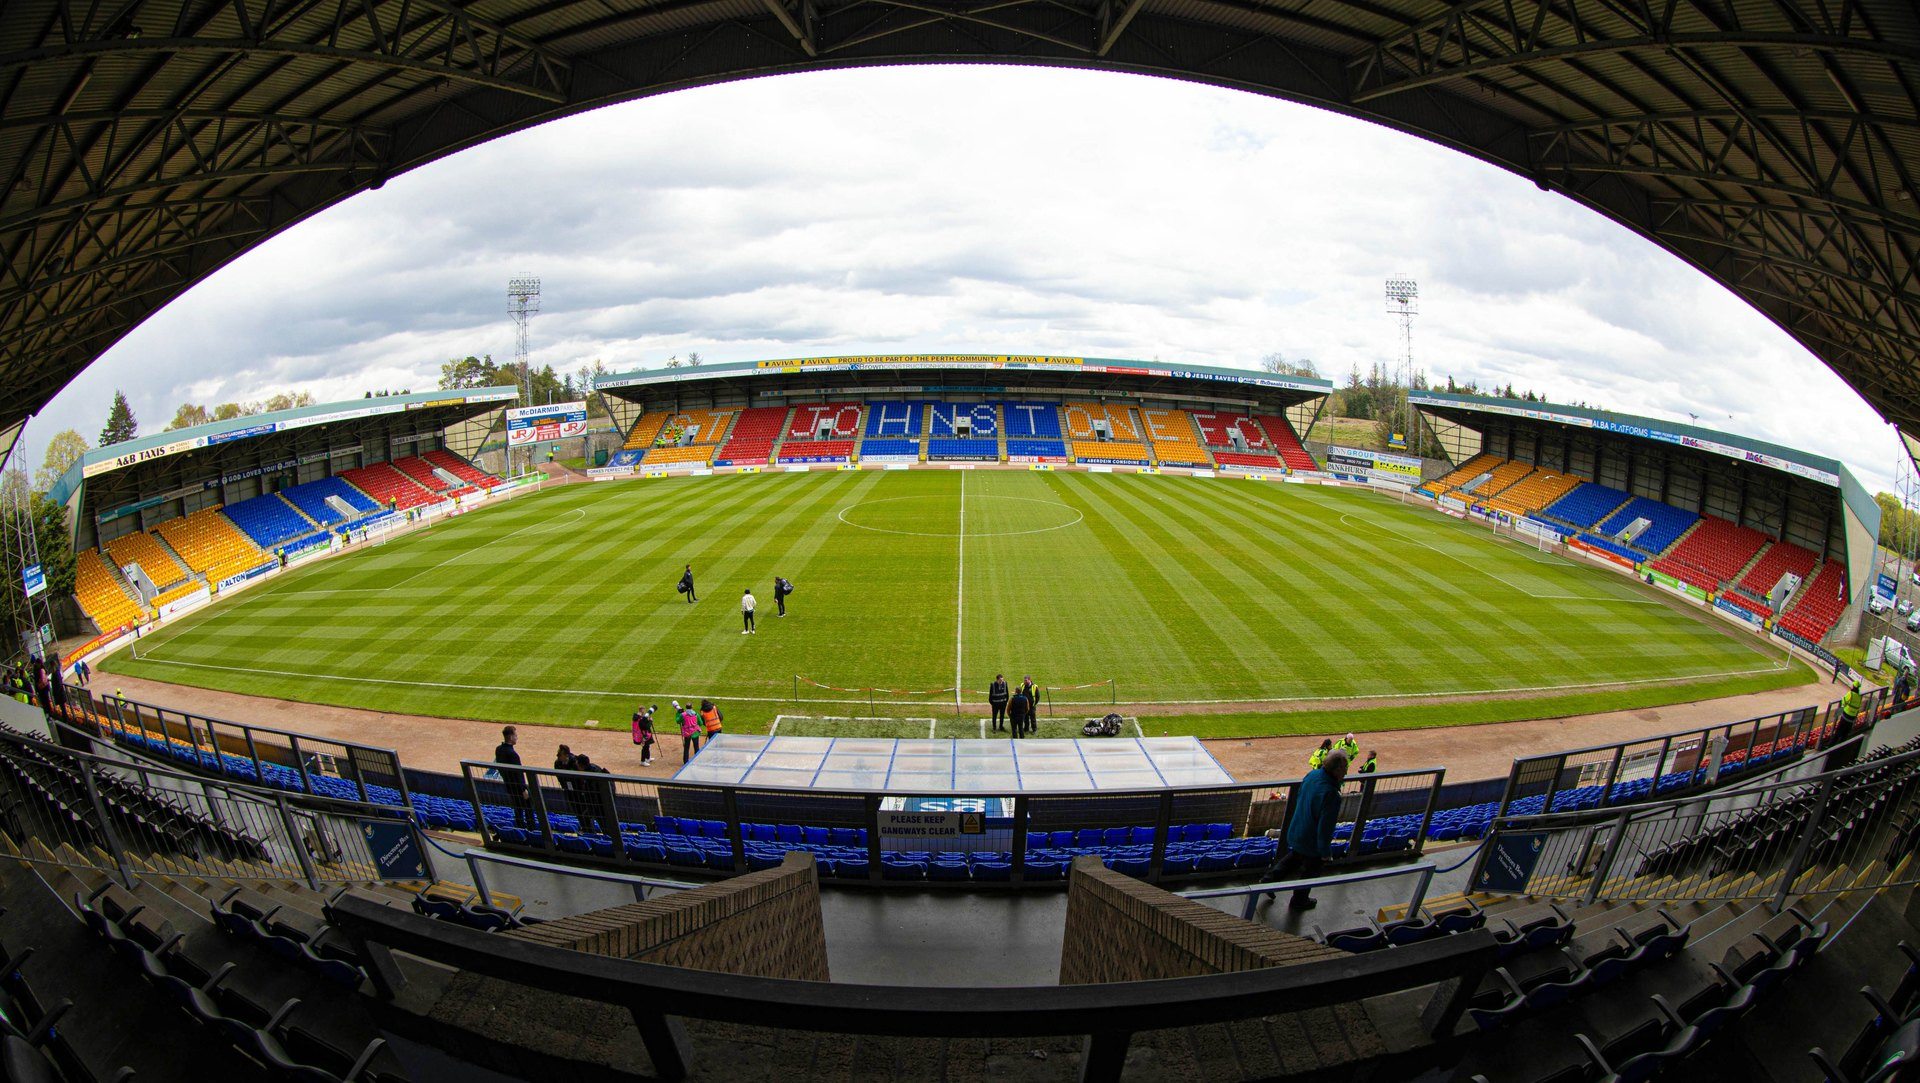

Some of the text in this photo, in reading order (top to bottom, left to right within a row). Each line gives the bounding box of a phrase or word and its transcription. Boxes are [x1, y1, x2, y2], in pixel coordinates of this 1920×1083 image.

[519, 406, 560, 416] McDIARMID
[563, 422, 578, 432] JR
[1592, 420, 1649, 437] ALBA PLATFORMS
[512, 429, 527, 439] JR
[1682, 437, 1698, 447] JAGS
[115, 455, 136, 468] A&B
[139, 446, 166, 461] TAXIS
[1745, 451, 1763, 463] JAGS
[228, 473, 241, 483] GOD
[242, 468, 262, 479] LOVES
[264, 464, 277, 474] YOU!
[1327, 463, 1367, 475] PANKHURST
[1779, 626, 1814, 651] Perthshire
[890, 815, 946, 823] PLEASE KEEP
[881, 826, 956, 835] GANGWAYS CLEAR
